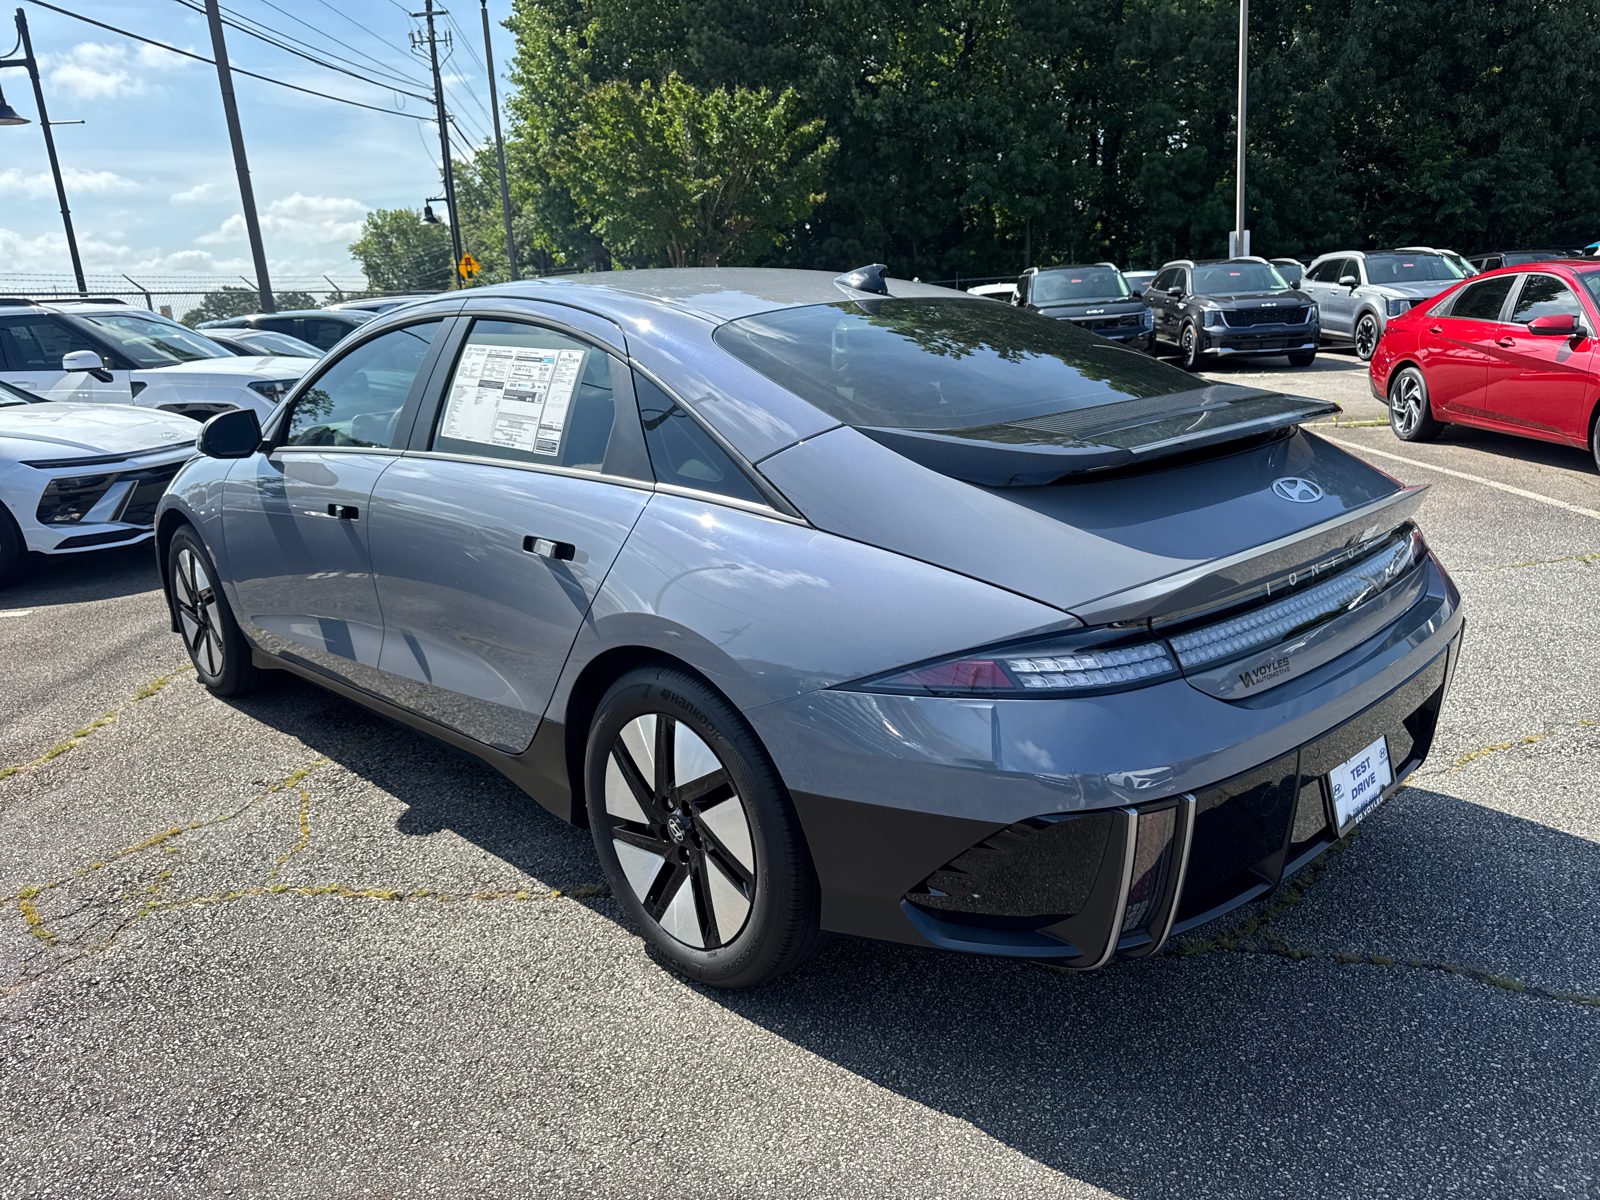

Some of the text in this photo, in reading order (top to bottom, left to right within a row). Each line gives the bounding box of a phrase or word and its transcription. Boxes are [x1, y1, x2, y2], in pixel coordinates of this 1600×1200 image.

[1252, 657, 1290, 678] VOYLES
[1255, 666, 1291, 685] AUTOMOTIVE
[1350, 756, 1371, 781] TEST
[1351, 771, 1377, 801] DRIVE
[1355, 813, 1363, 824] ED
[1363, 794, 1384, 816] VOYLES
